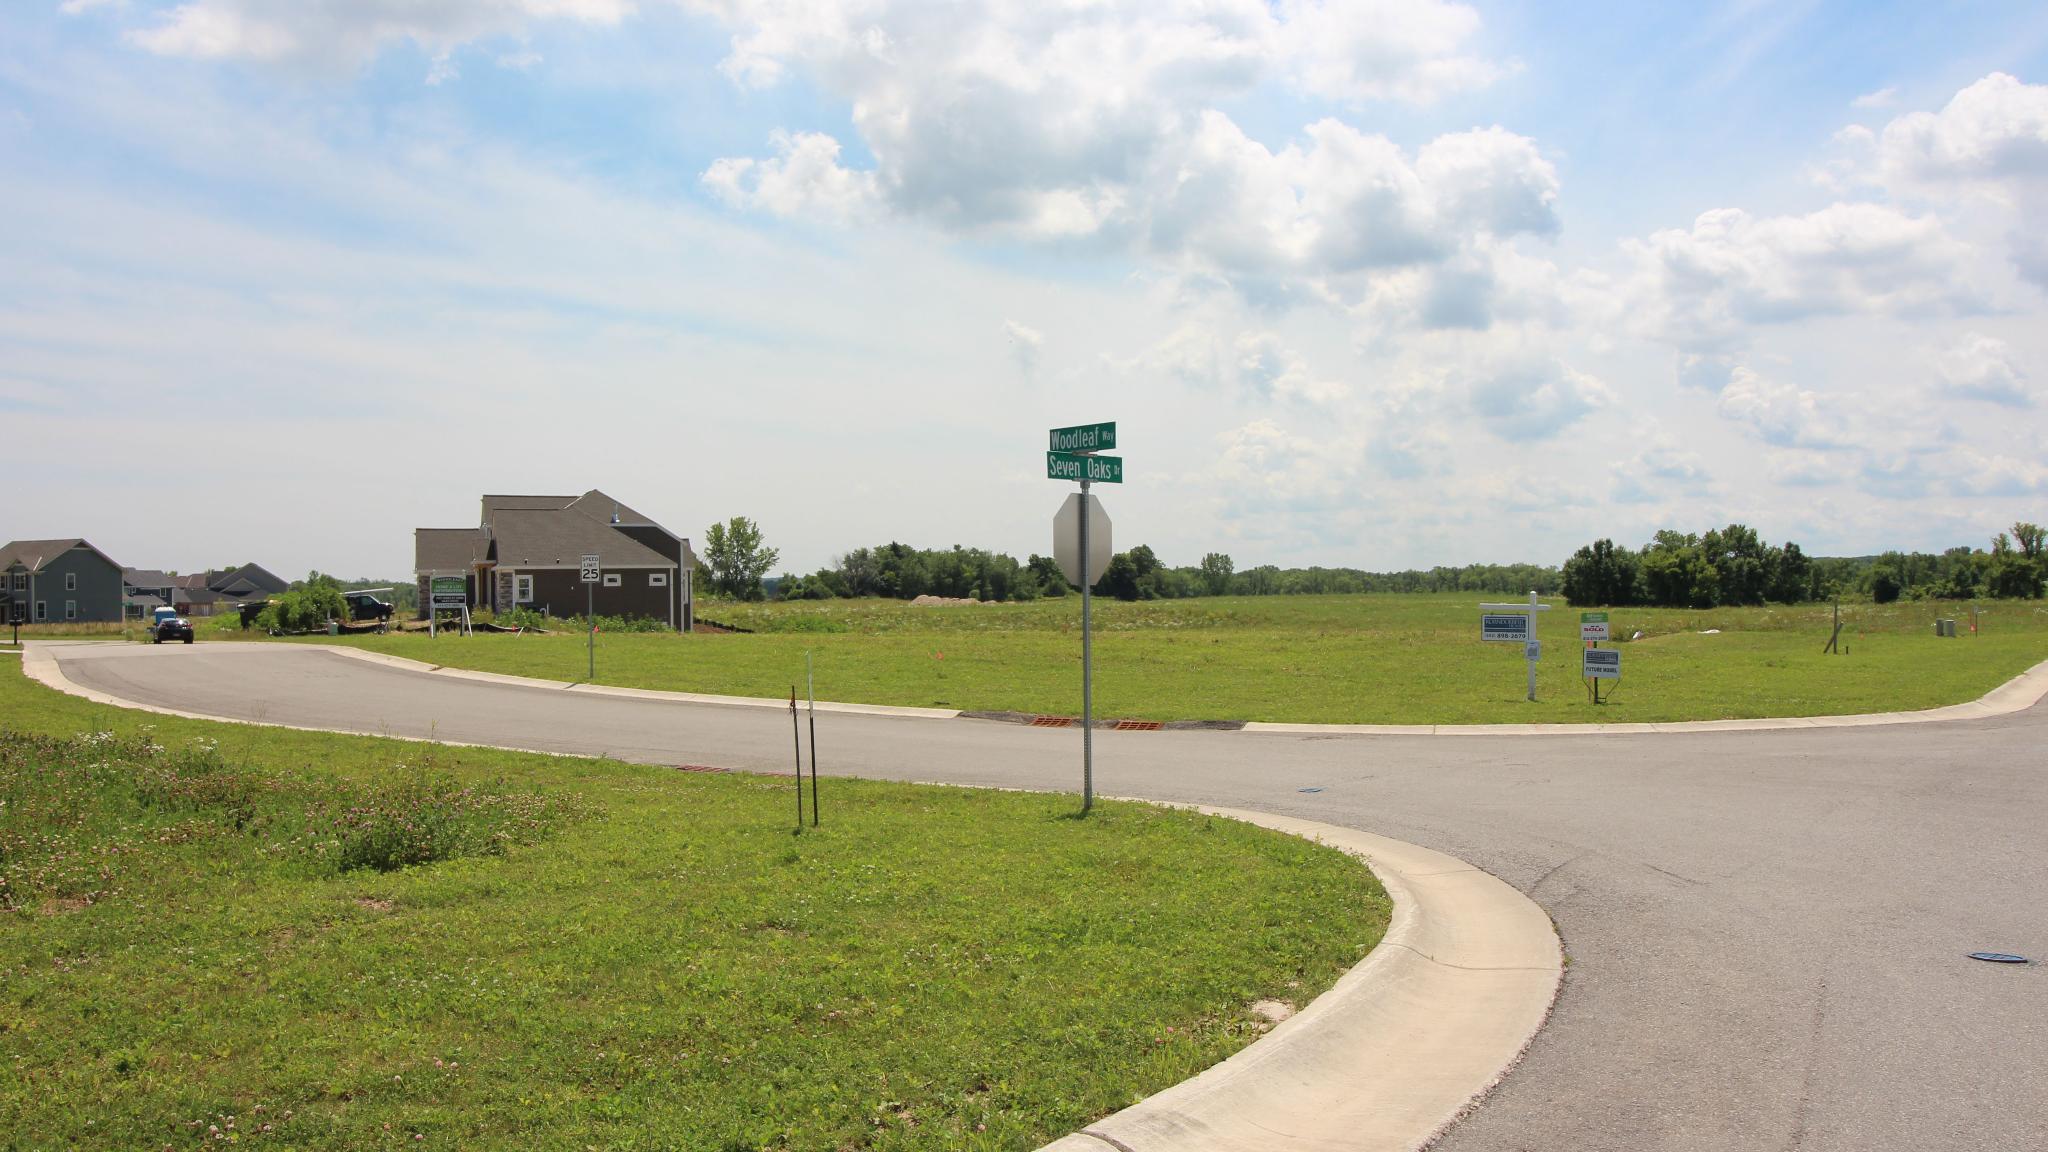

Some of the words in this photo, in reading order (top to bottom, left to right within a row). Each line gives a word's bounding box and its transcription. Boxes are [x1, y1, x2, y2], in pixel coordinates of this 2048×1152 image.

[1051, 427, 1099, 450] Woodleaf
[1102, 431, 1114, 442] Way
[1049, 455, 1080, 477] Seven
[1087, 458, 1111, 479] Oaks
[1114, 465, 1120, 475] Dr
[582, 568, 599, 579] 25
